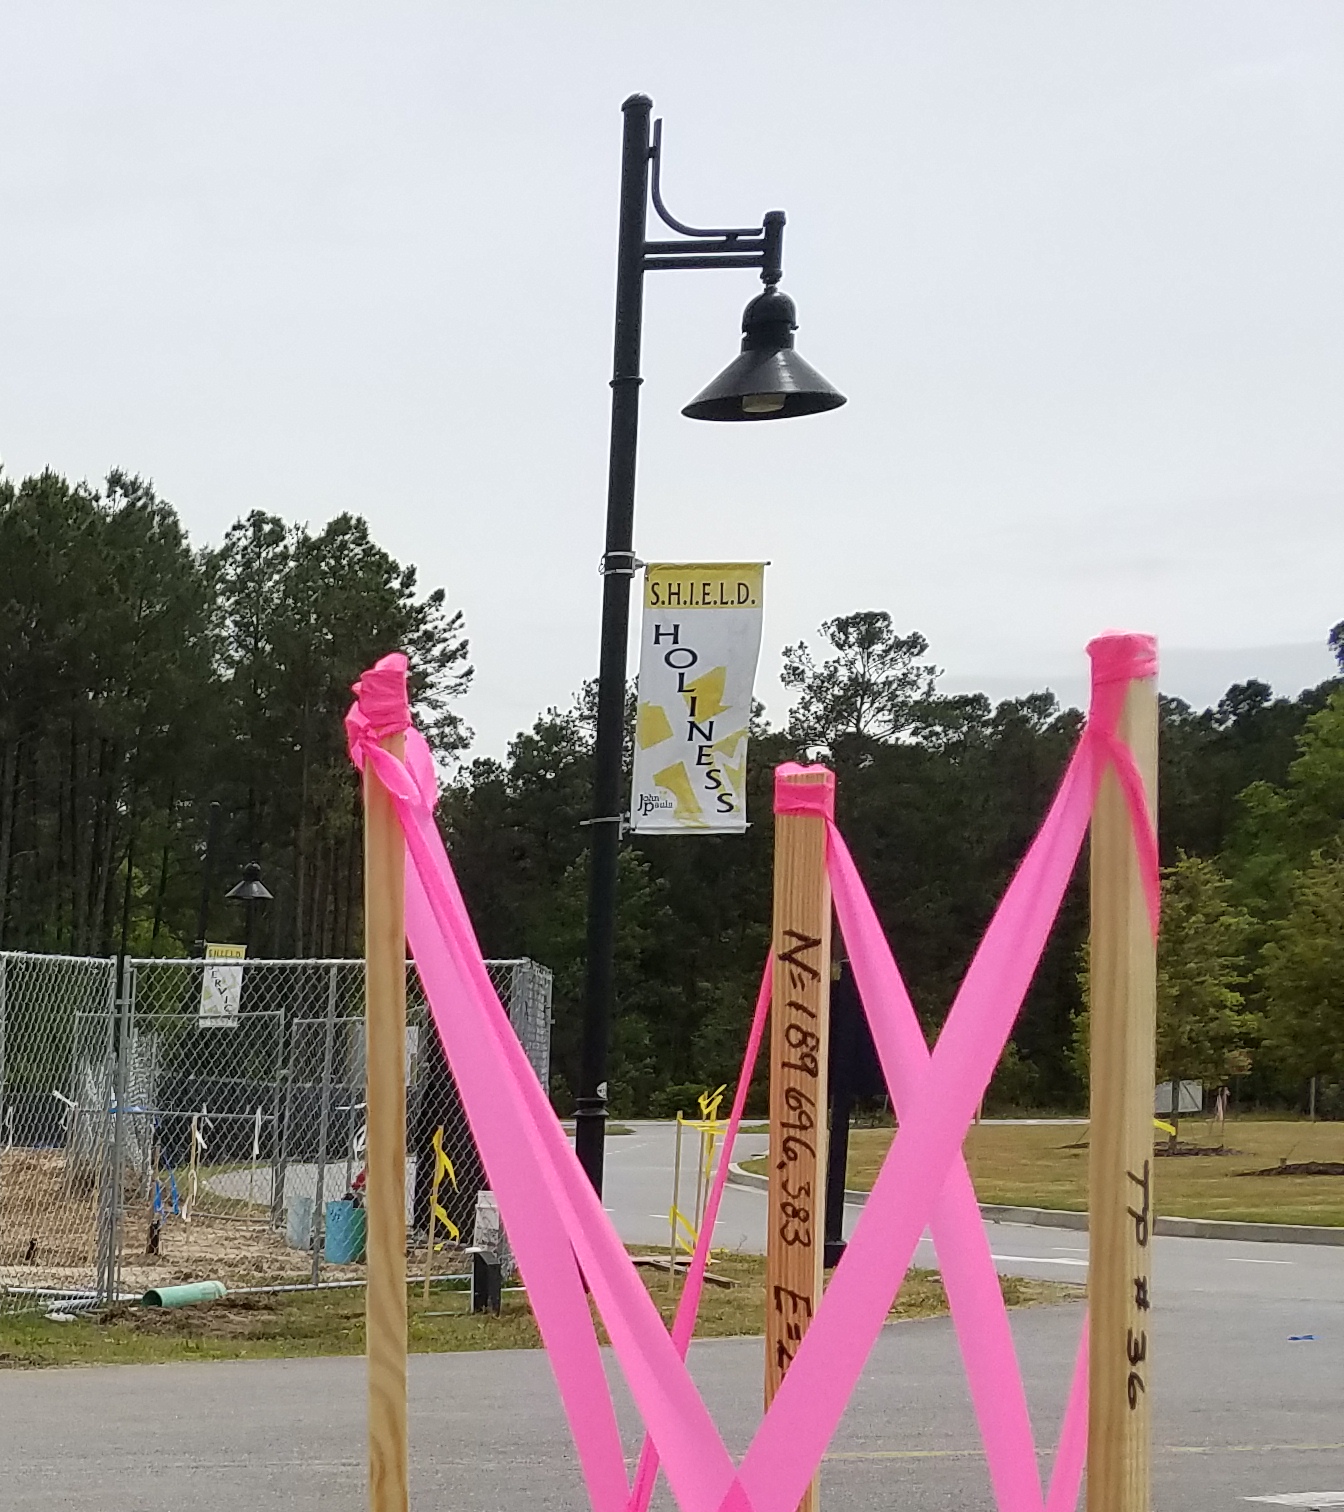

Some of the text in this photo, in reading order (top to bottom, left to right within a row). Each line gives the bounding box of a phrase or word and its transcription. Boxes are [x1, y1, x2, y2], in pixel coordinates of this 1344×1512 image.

[650, 582, 756, 606] S.H.I.E.L.D.
[653, 623, 735, 813] HOLINESS
[637, 794, 660, 811] John
[1126, 1159, 1150, 1247] TP
[1126, 1327, 1148, 1410] 36
